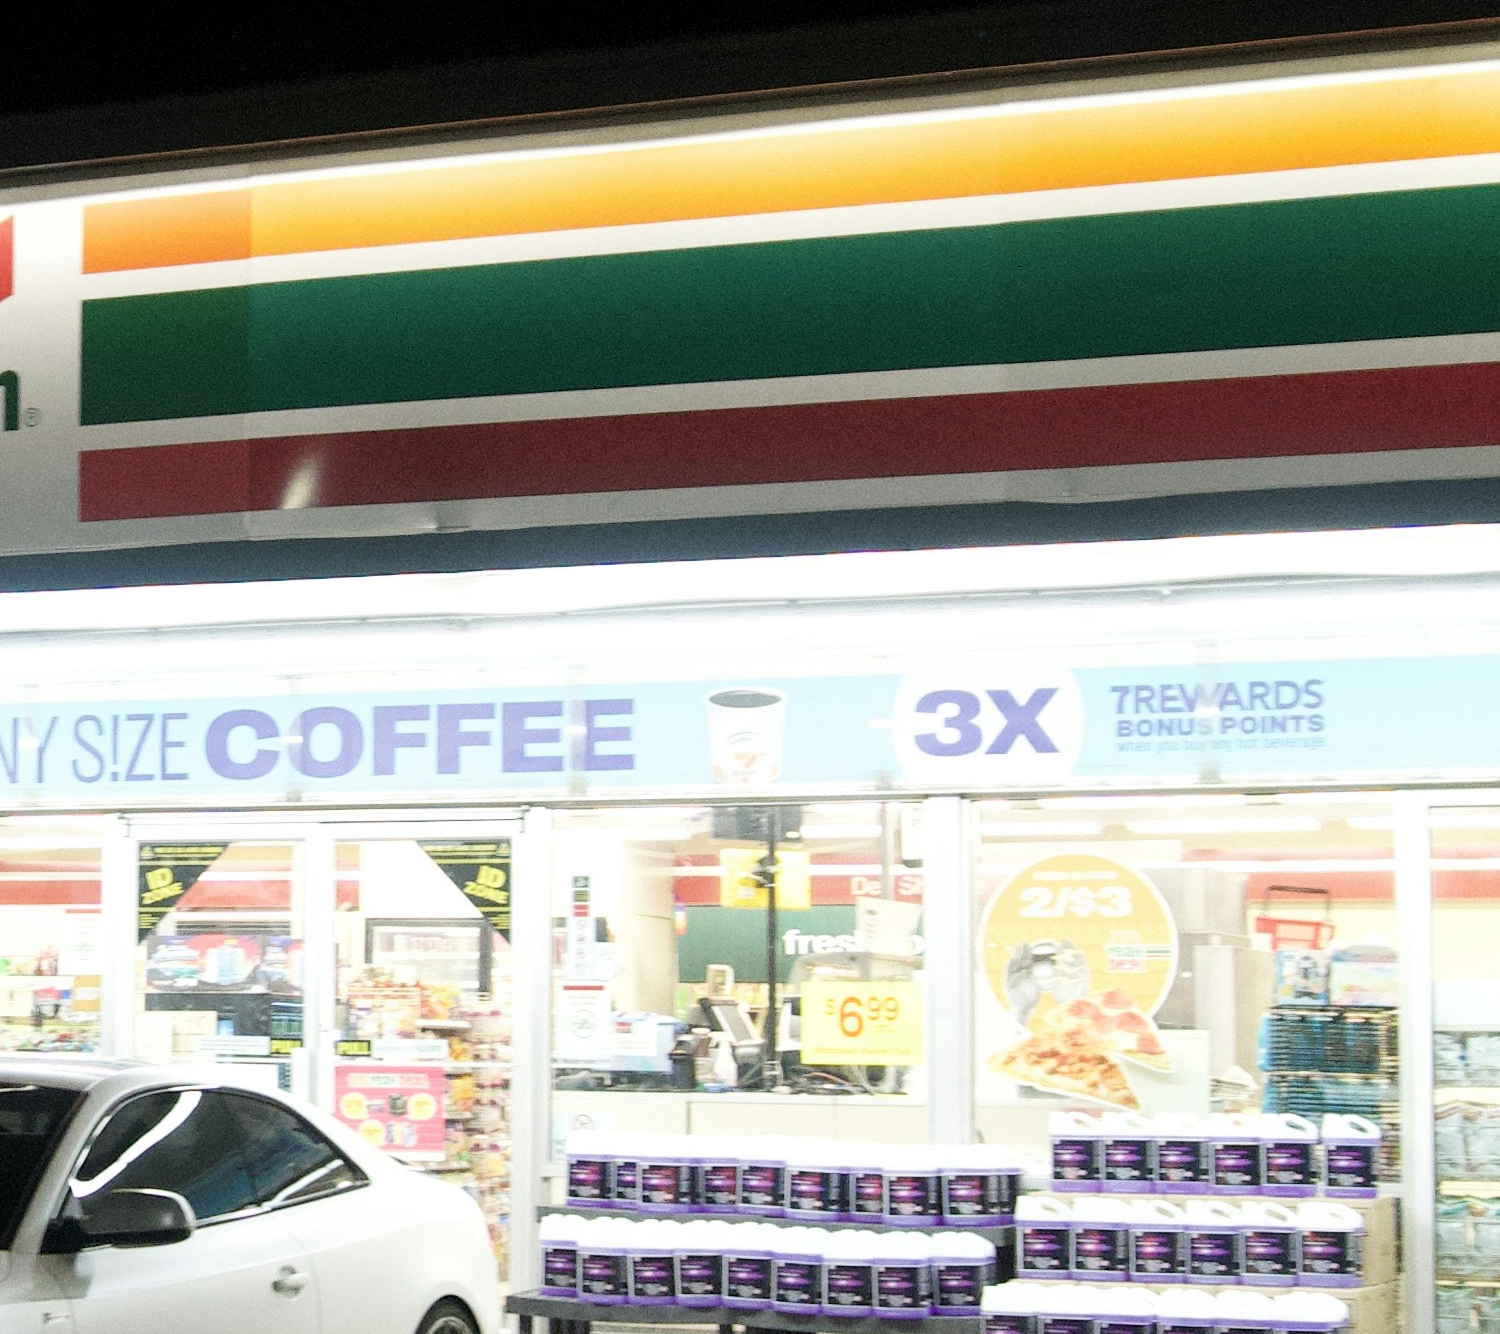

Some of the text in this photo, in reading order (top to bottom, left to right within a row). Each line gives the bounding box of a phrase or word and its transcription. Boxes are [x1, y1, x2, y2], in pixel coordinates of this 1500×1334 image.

[1110, 678, 1326, 715] 7REWARDS
[914, 687, 1061, 757] 3X
[1115, 714, 1326, 738] BONUS POINTS
[204, 697, 636, 780] COFFEE
[144, 867, 174, 891] ID
[475, 864, 507, 890] ID
[140, 881, 185, 905] ZONE
[462, 880, 510, 905] ZONE
[1018, 885, 1133, 918] 2/$3
[782, 929, 859, 955] fres
